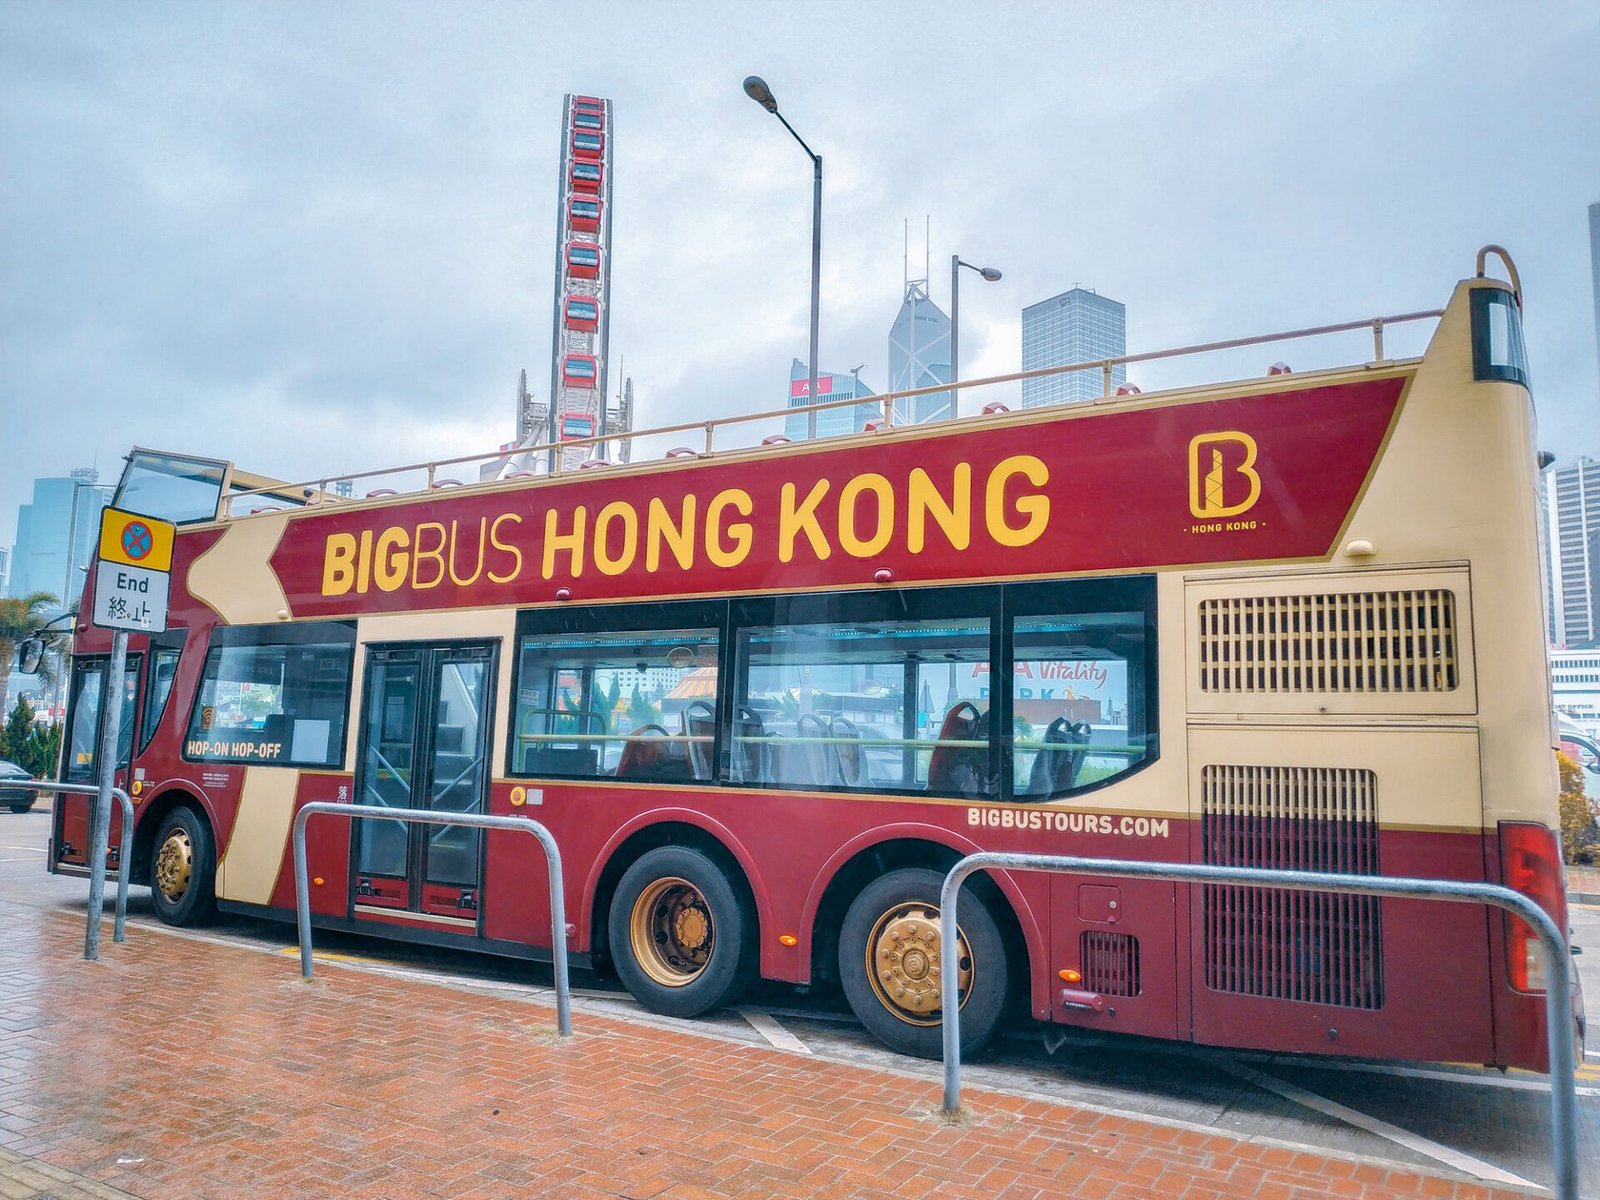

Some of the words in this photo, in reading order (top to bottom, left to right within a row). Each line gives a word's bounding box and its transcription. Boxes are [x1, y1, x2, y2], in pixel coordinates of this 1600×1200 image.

[1188, 431, 1261, 518] B
[322, 513, 522, 596] BIGBUS
[542, 488, 753, 580] HONG
[779, 455, 1050, 563] KONG
[1192, 523, 1222, 533] HONG
[1226, 520, 1257, 531] KONG
[117, 572, 149, 593] End
[108, 596, 151, 623] 終止
[971, 661, 1033, 679] AA
[1040, 660, 1107, 689] Vitality
[980, 687, 1055, 699] PRK
[187, 740, 229, 756] HOP-ON
[231, 742, 281, 758] HOP-OFF
[967, 807, 1169, 838] BIGBUSTOURS.COM
